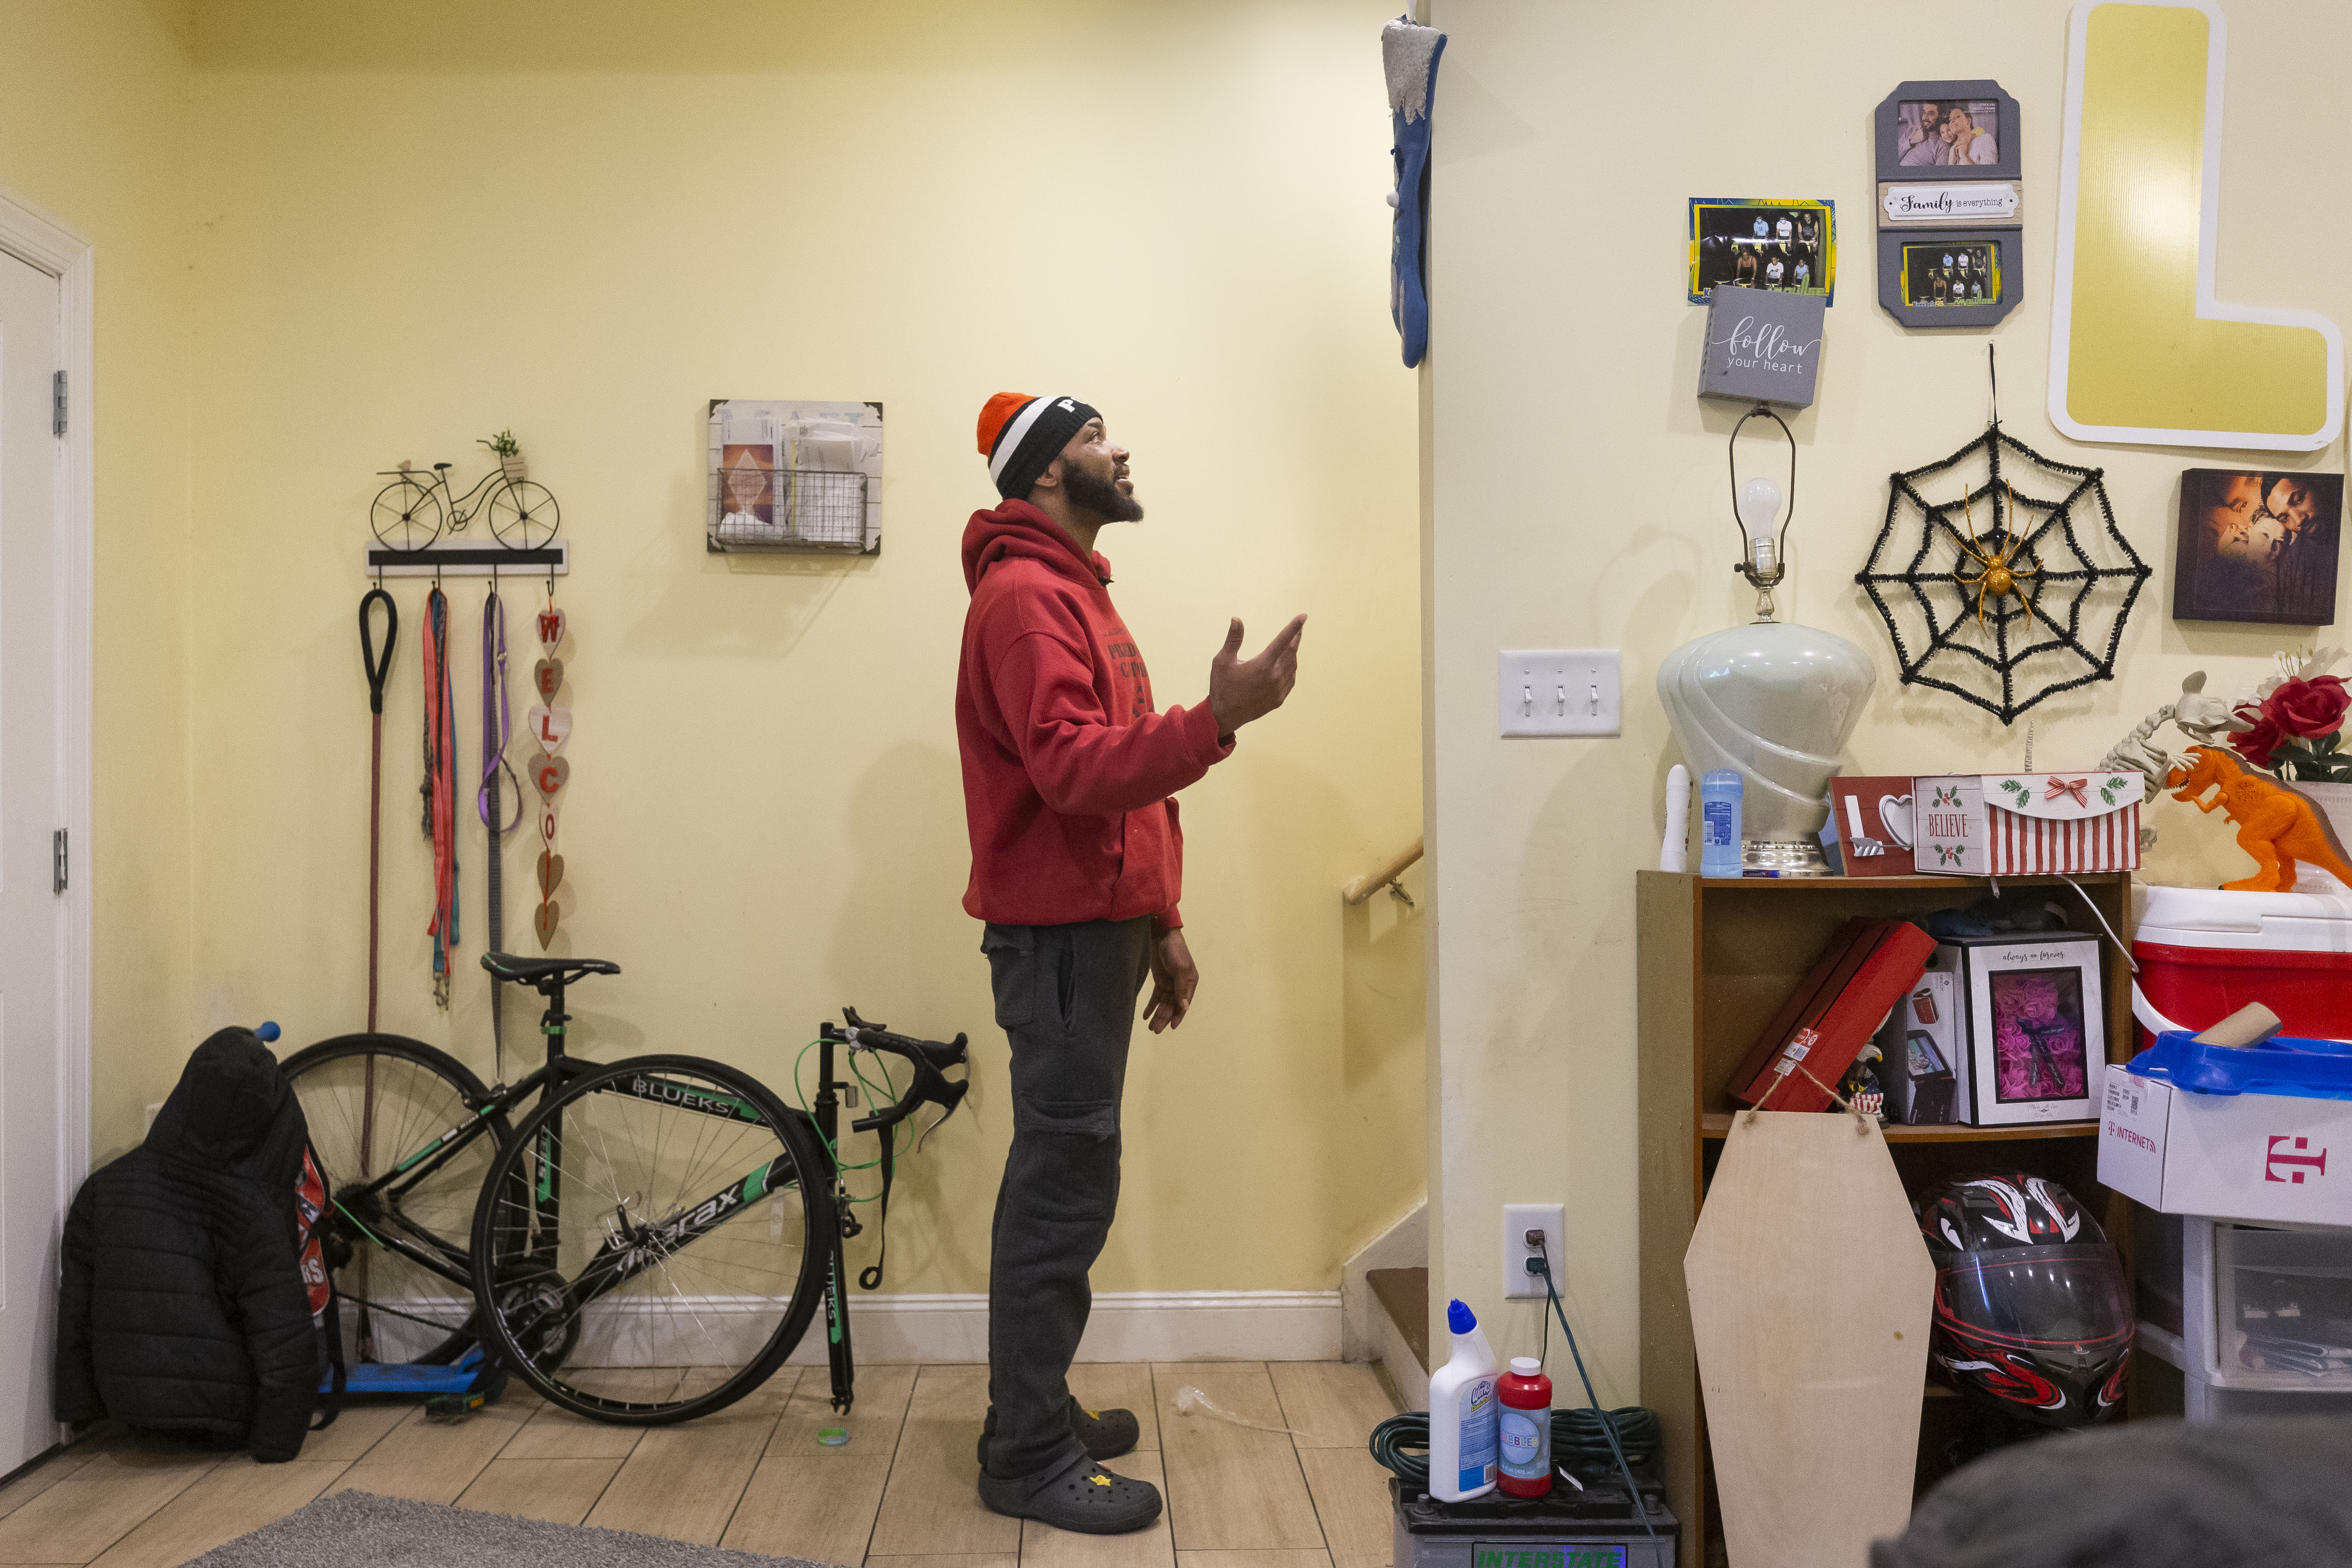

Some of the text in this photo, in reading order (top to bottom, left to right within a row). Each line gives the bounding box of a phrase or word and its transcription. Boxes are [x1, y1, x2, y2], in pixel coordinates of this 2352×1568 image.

[1900, 192, 1953, 213] Family
[1963, 198, 2003, 208] everything
[1711, 316, 1821, 360] follow
[1727, 357, 1802, 374] your heart
[1928, 814, 1968, 837] BELIEVE
[2003, 951, 2028, 963] always
[2040, 950, 2065, 961] forever
[632, 1079, 729, 1114] BLUEKS
[2117, 1126, 2150, 1150] INTERNET
[1471, 1381, 1491, 1405] Works
[1500, 1430, 1538, 1447] BUBBLES
[1477, 1551, 1623, 1568] INTERSTATE
